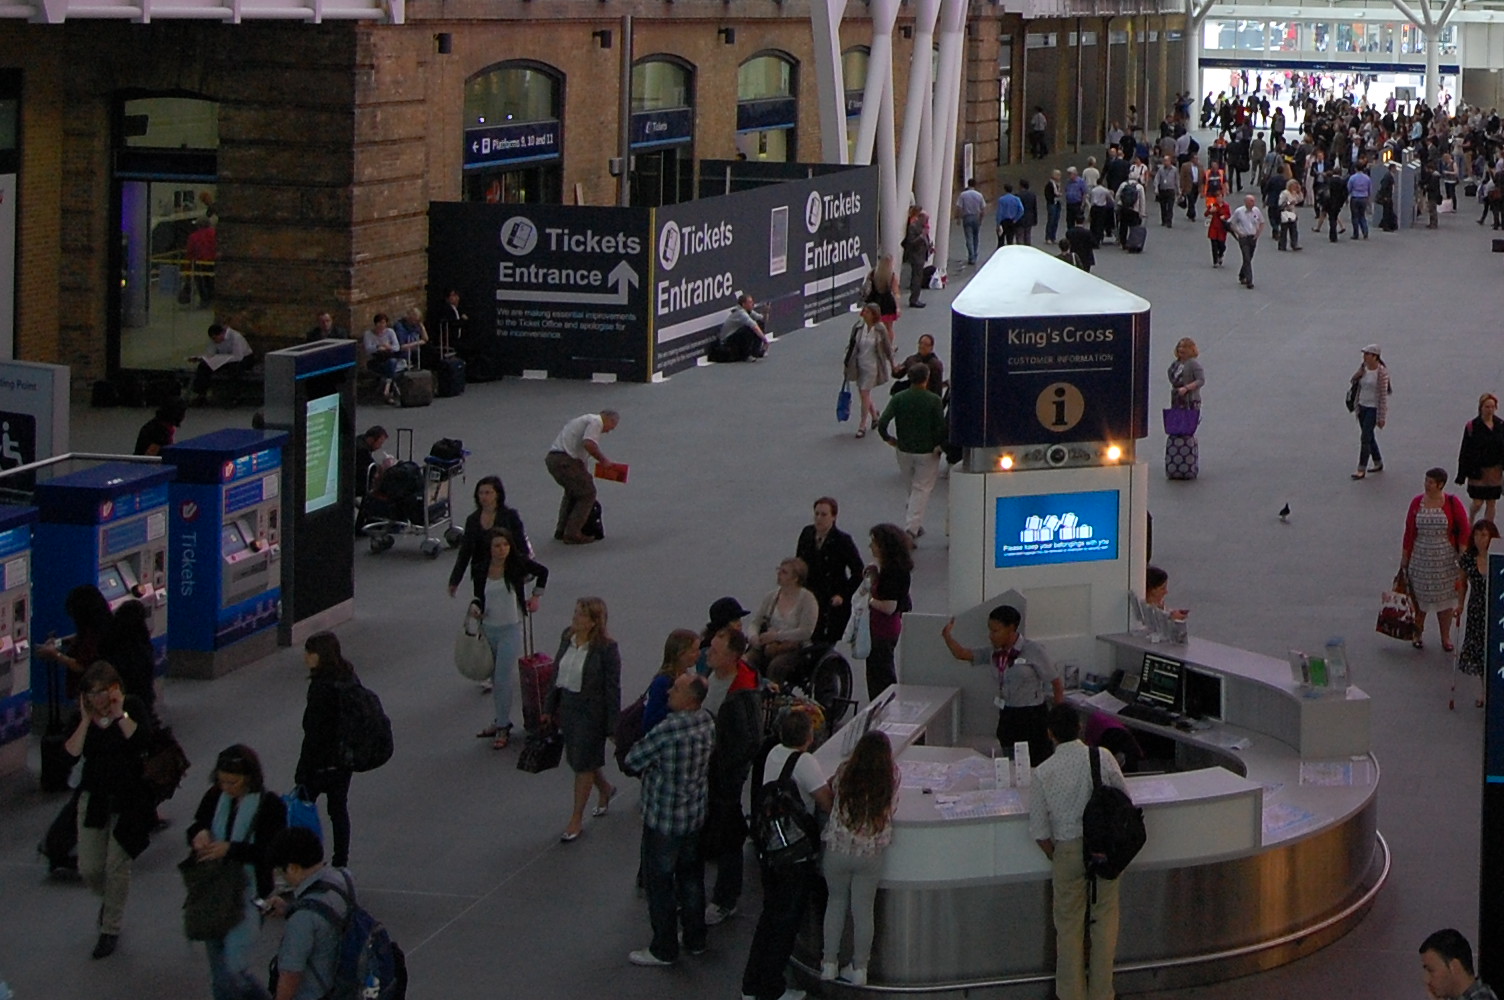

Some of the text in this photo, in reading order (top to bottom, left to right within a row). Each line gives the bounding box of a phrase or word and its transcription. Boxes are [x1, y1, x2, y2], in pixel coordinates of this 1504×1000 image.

[492, 137, 520, 151] Platforms
[535, 134, 546, 146] and
[823, 191, 861, 221] Tickets
[545, 228, 641, 254] Tickets
[681, 220, 733, 256] Tickets
[804, 235, 861, 272] Entrance
[499, 261, 602, 286] Entrance
[657, 271, 733, 316] Entrance
[496, 307, 510, 316] We
[524, 309, 551, 319] making
[552, 310, 584, 319] essential
[585, 312, 637, 321] improvements
[505, 319, 517, 327] the
[519, 318, 540, 327] Ticket
[541, 319, 563, 328] Office
[563, 320, 578, 329] and
[579, 321, 614, 332] apologise
[615, 322, 626, 330] for
[496, 328, 508, 336] the
[1008, 326, 1114, 348] King's Cross
[1008, 353, 1114, 366] CUSTOMER INFORMATION
[16, 379, 37, 391] Point
[1053, 541, 1085, 549] belongings
[181, 533, 197, 597] Tickets
